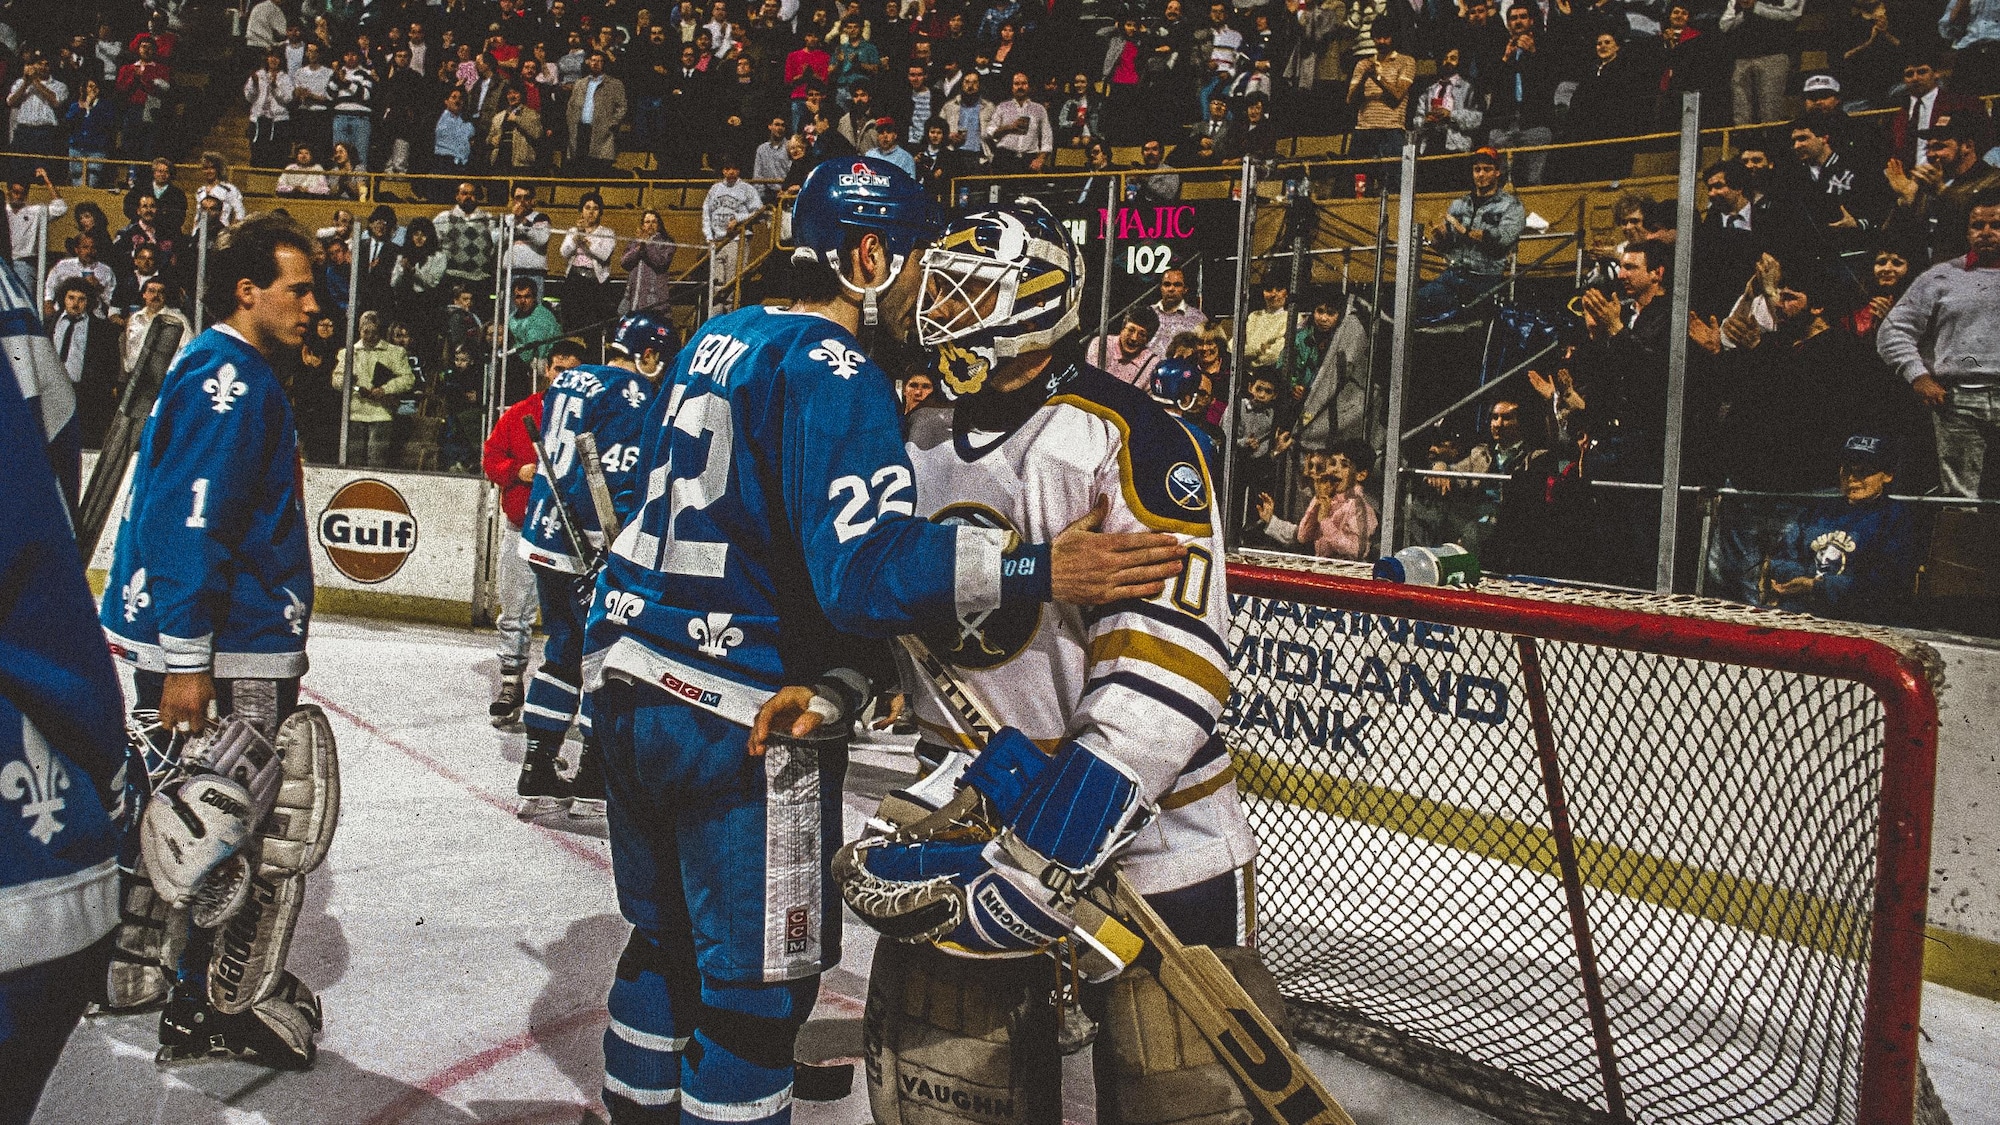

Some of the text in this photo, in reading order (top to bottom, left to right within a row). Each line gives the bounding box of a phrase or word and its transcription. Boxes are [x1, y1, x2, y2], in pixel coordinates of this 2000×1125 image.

[839, 174, 890, 188] CCM
[1096, 205, 1196, 239] MAJIC
[1126, 244, 1172, 274] 102
[601, 442, 641, 473] 46
[185, 477, 210, 528] 1
[828, 464, 914, 544] 22
[323, 513, 412, 548] Gulf
[1168, 542, 1214, 620] 0
[662, 675, 721, 705] CCM
[788, 909, 808, 952] CCM
[902, 1074, 1014, 1119] VAUGHN
